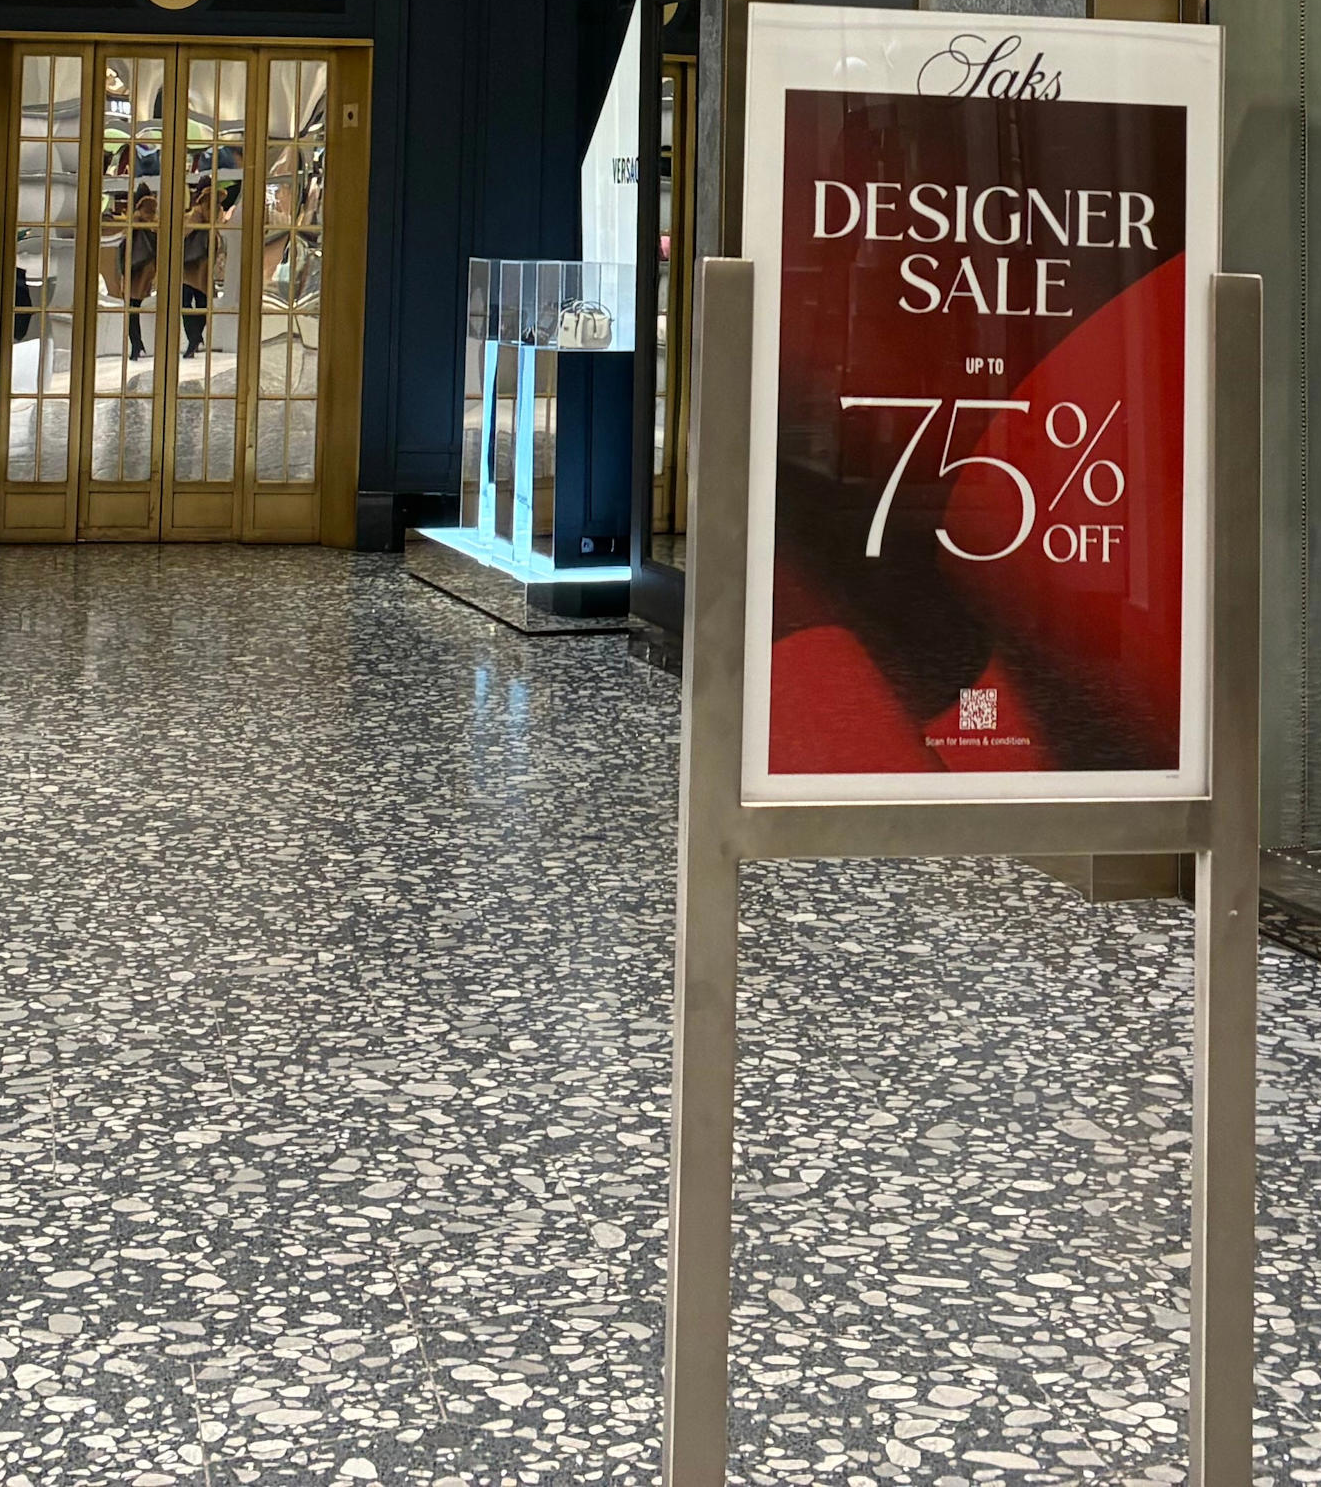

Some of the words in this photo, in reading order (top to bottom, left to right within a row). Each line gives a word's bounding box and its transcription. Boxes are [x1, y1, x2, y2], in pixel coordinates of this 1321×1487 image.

[916, 34, 1063, 101] Saks
[813, 180, 1158, 251] DESIGNER
[898, 253, 1074, 317] SALE
[965, 357, 984, 375] UP
[987, 358, 1005, 375] TO
[1043, 523, 1124, 563] OFF
[925, 736, 945, 746] Scan
[946, 736, 957, 746] for
[959, 736, 980, 746] terms
[991, 736, 1031, 746] conditions
